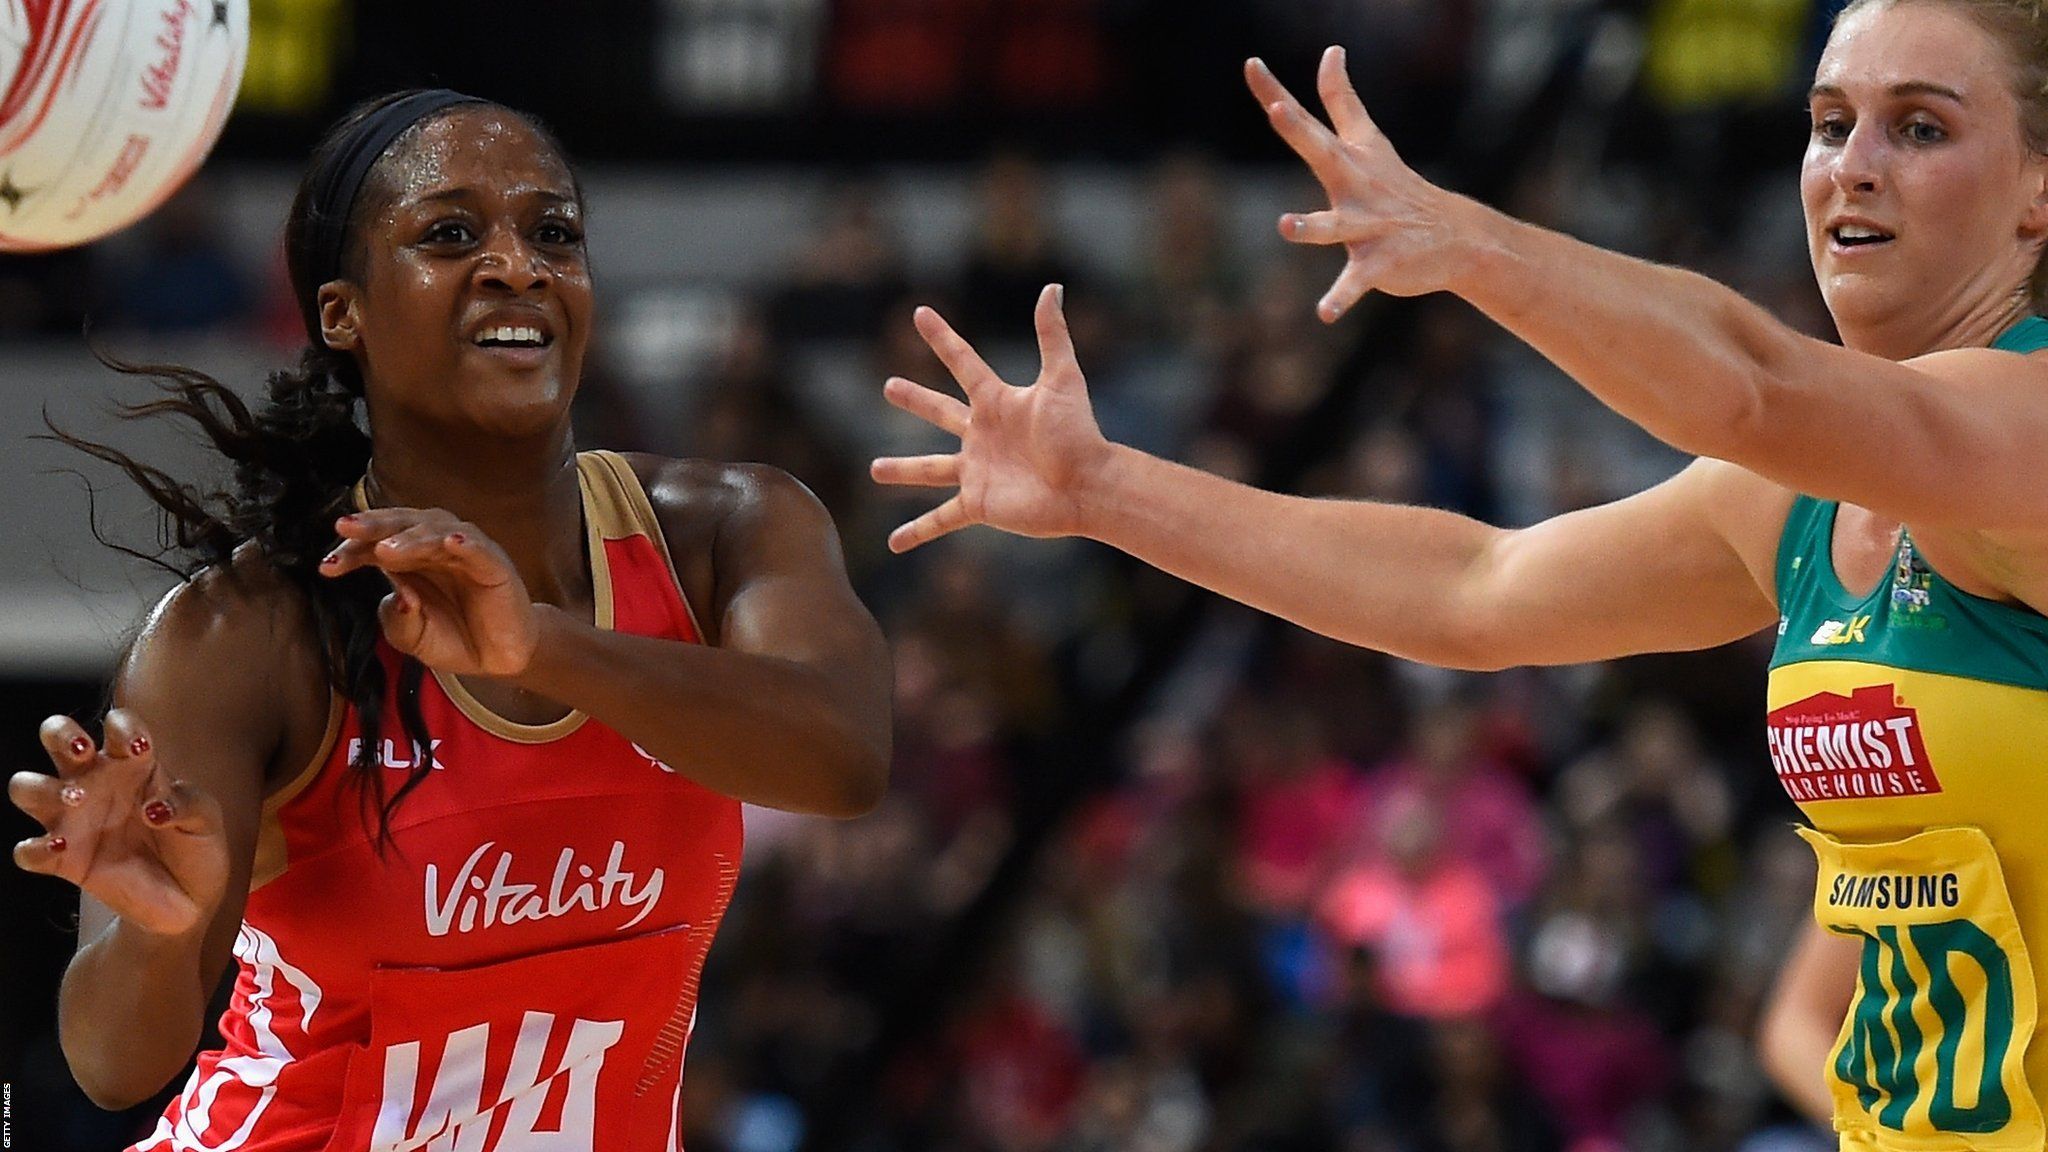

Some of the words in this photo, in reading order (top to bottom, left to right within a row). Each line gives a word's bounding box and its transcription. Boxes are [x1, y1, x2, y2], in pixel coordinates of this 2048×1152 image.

[1767, 716, 1915, 775] CHEMIST
[425, 840, 666, 938] Vitality
[1829, 873, 1959, 909] SAMSUNG
